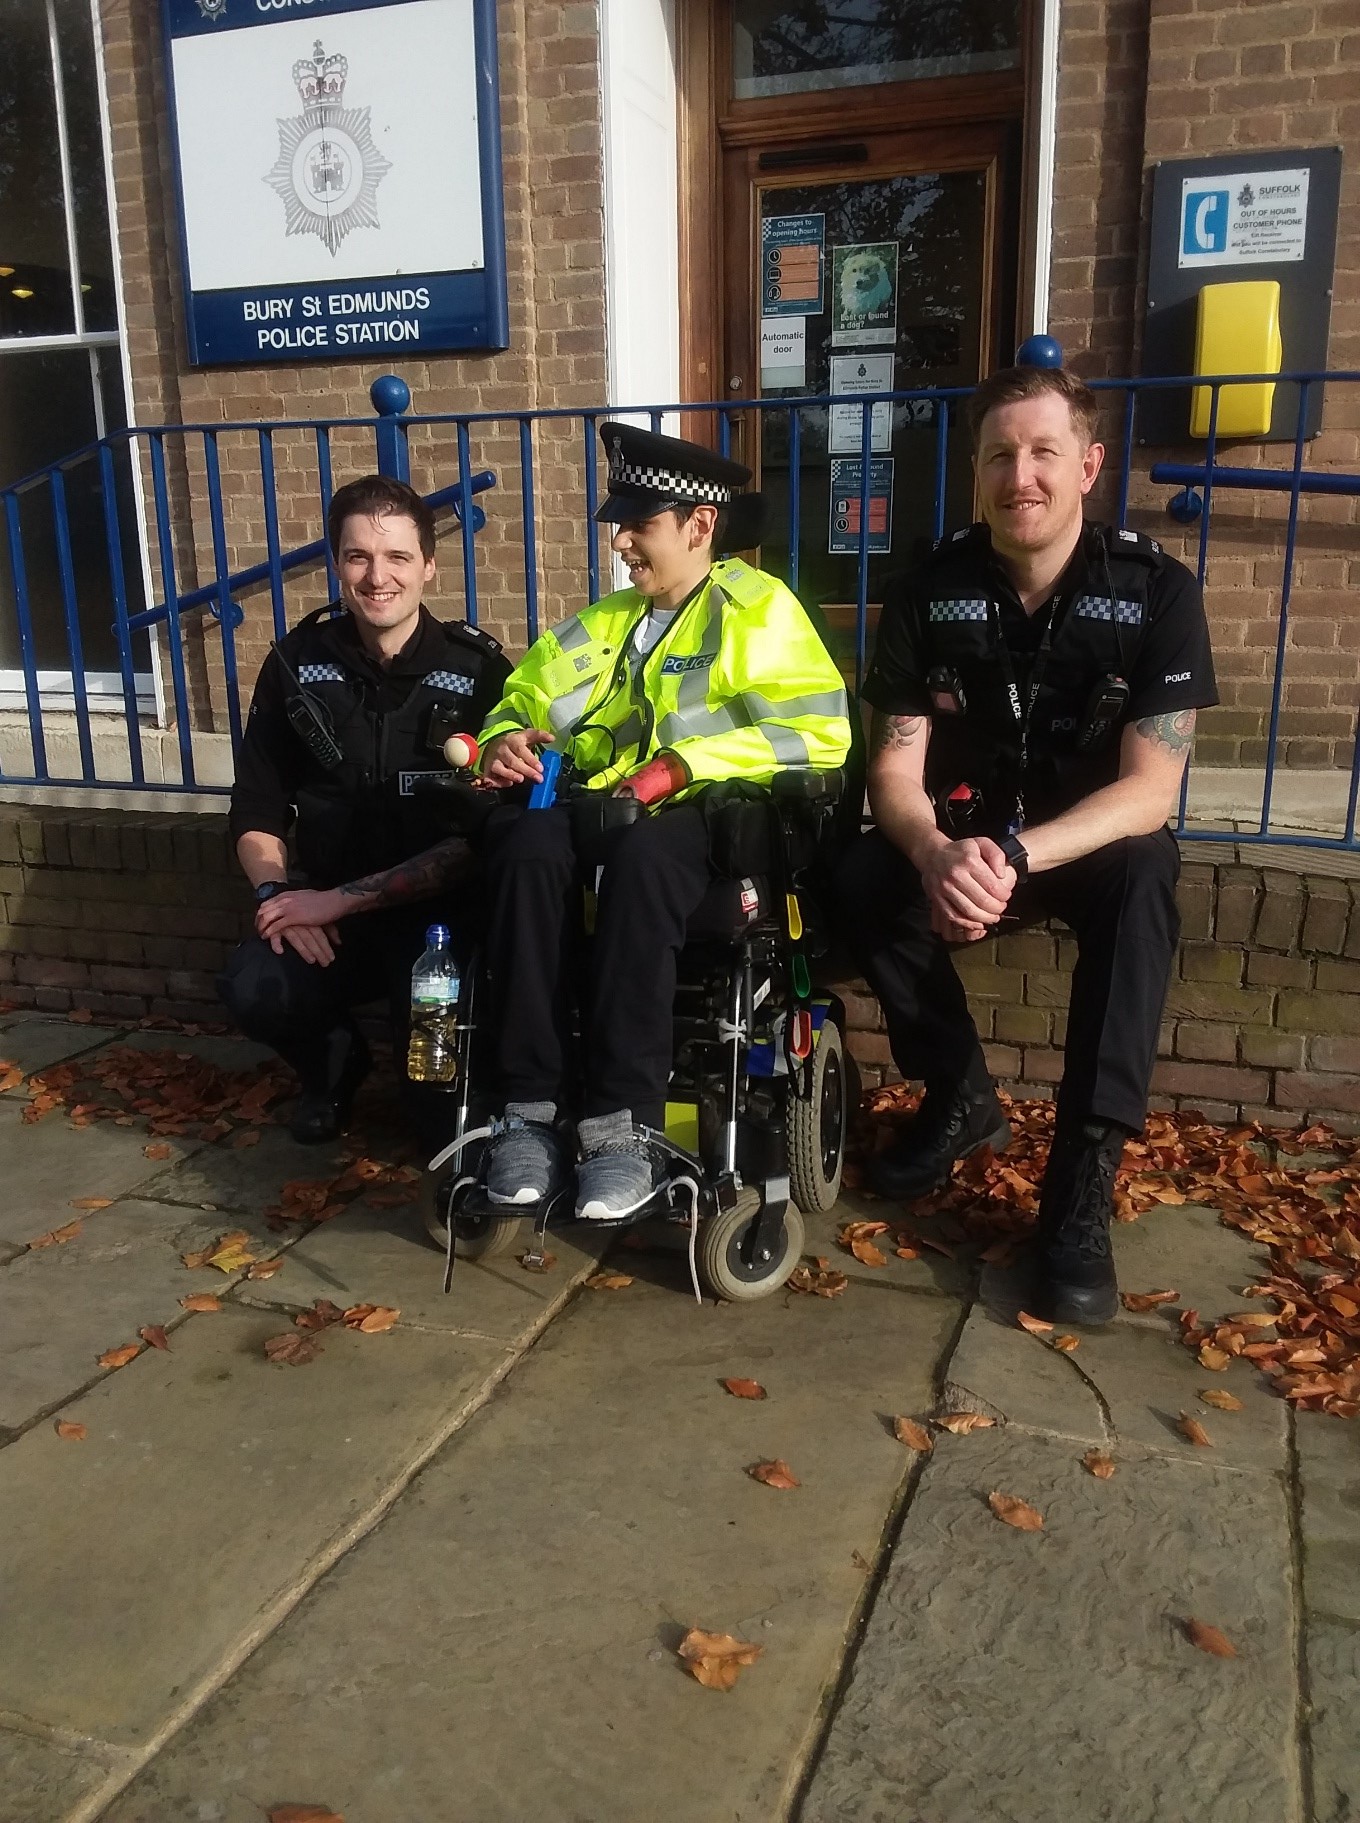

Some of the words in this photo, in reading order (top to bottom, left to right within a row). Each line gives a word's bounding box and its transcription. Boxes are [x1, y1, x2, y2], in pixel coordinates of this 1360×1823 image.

[1259, 184, 1301, 195] SUFFOLK
[1240, 210, 1256, 218] OUT
[1258, 209, 1268, 217] OF
[1270, 207, 1297, 216] HOURS
[777, 220, 804, 228] Changes
[1233, 220, 1275, 229] CUSTOMER
[1276, 218, 1303, 226] PHONE
[772, 229, 798, 238] opening
[243, 298, 294, 321] BURY
[302, 296, 322, 318] St
[328, 287, 431, 315] EDMUNDS
[840, 313, 857, 322] Lost
[868, 310, 889, 321] found
[257, 325, 329, 350] POLICE
[335, 319, 421, 345] STATION
[762, 331, 804, 342] Automatic
[773, 345, 793, 354] door
[663, 655, 715, 672] POLICE
[1165, 671, 1192, 685] POLICE
[1007, 683, 1022, 720] POLICE
